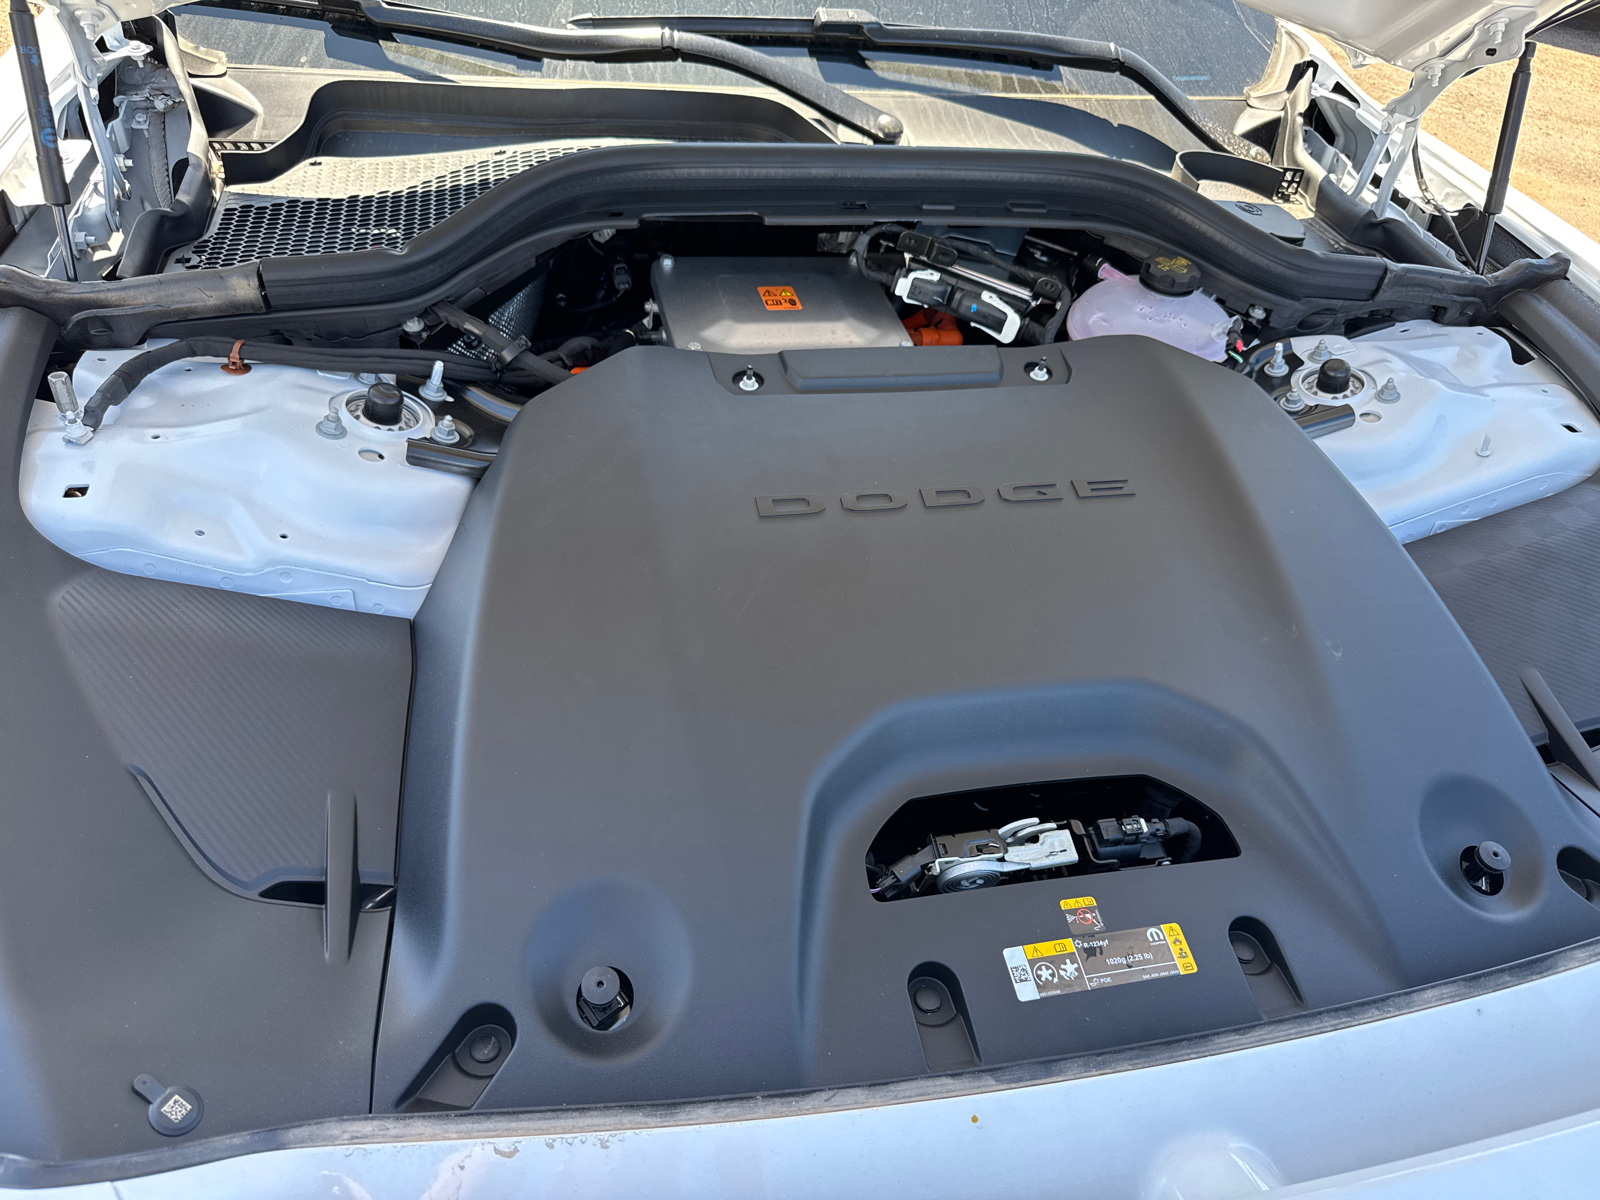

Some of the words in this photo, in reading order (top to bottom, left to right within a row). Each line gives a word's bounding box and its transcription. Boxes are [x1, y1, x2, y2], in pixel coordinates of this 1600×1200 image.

[755, 479, 1136, 518] DODGE
[1083, 939, 1109, 949] R-1234yf
[1105, 957, 1127, 966] 1020g
[1126, 953, 1143, 964] (2.25
[1143, 951, 1154, 961] lb)
